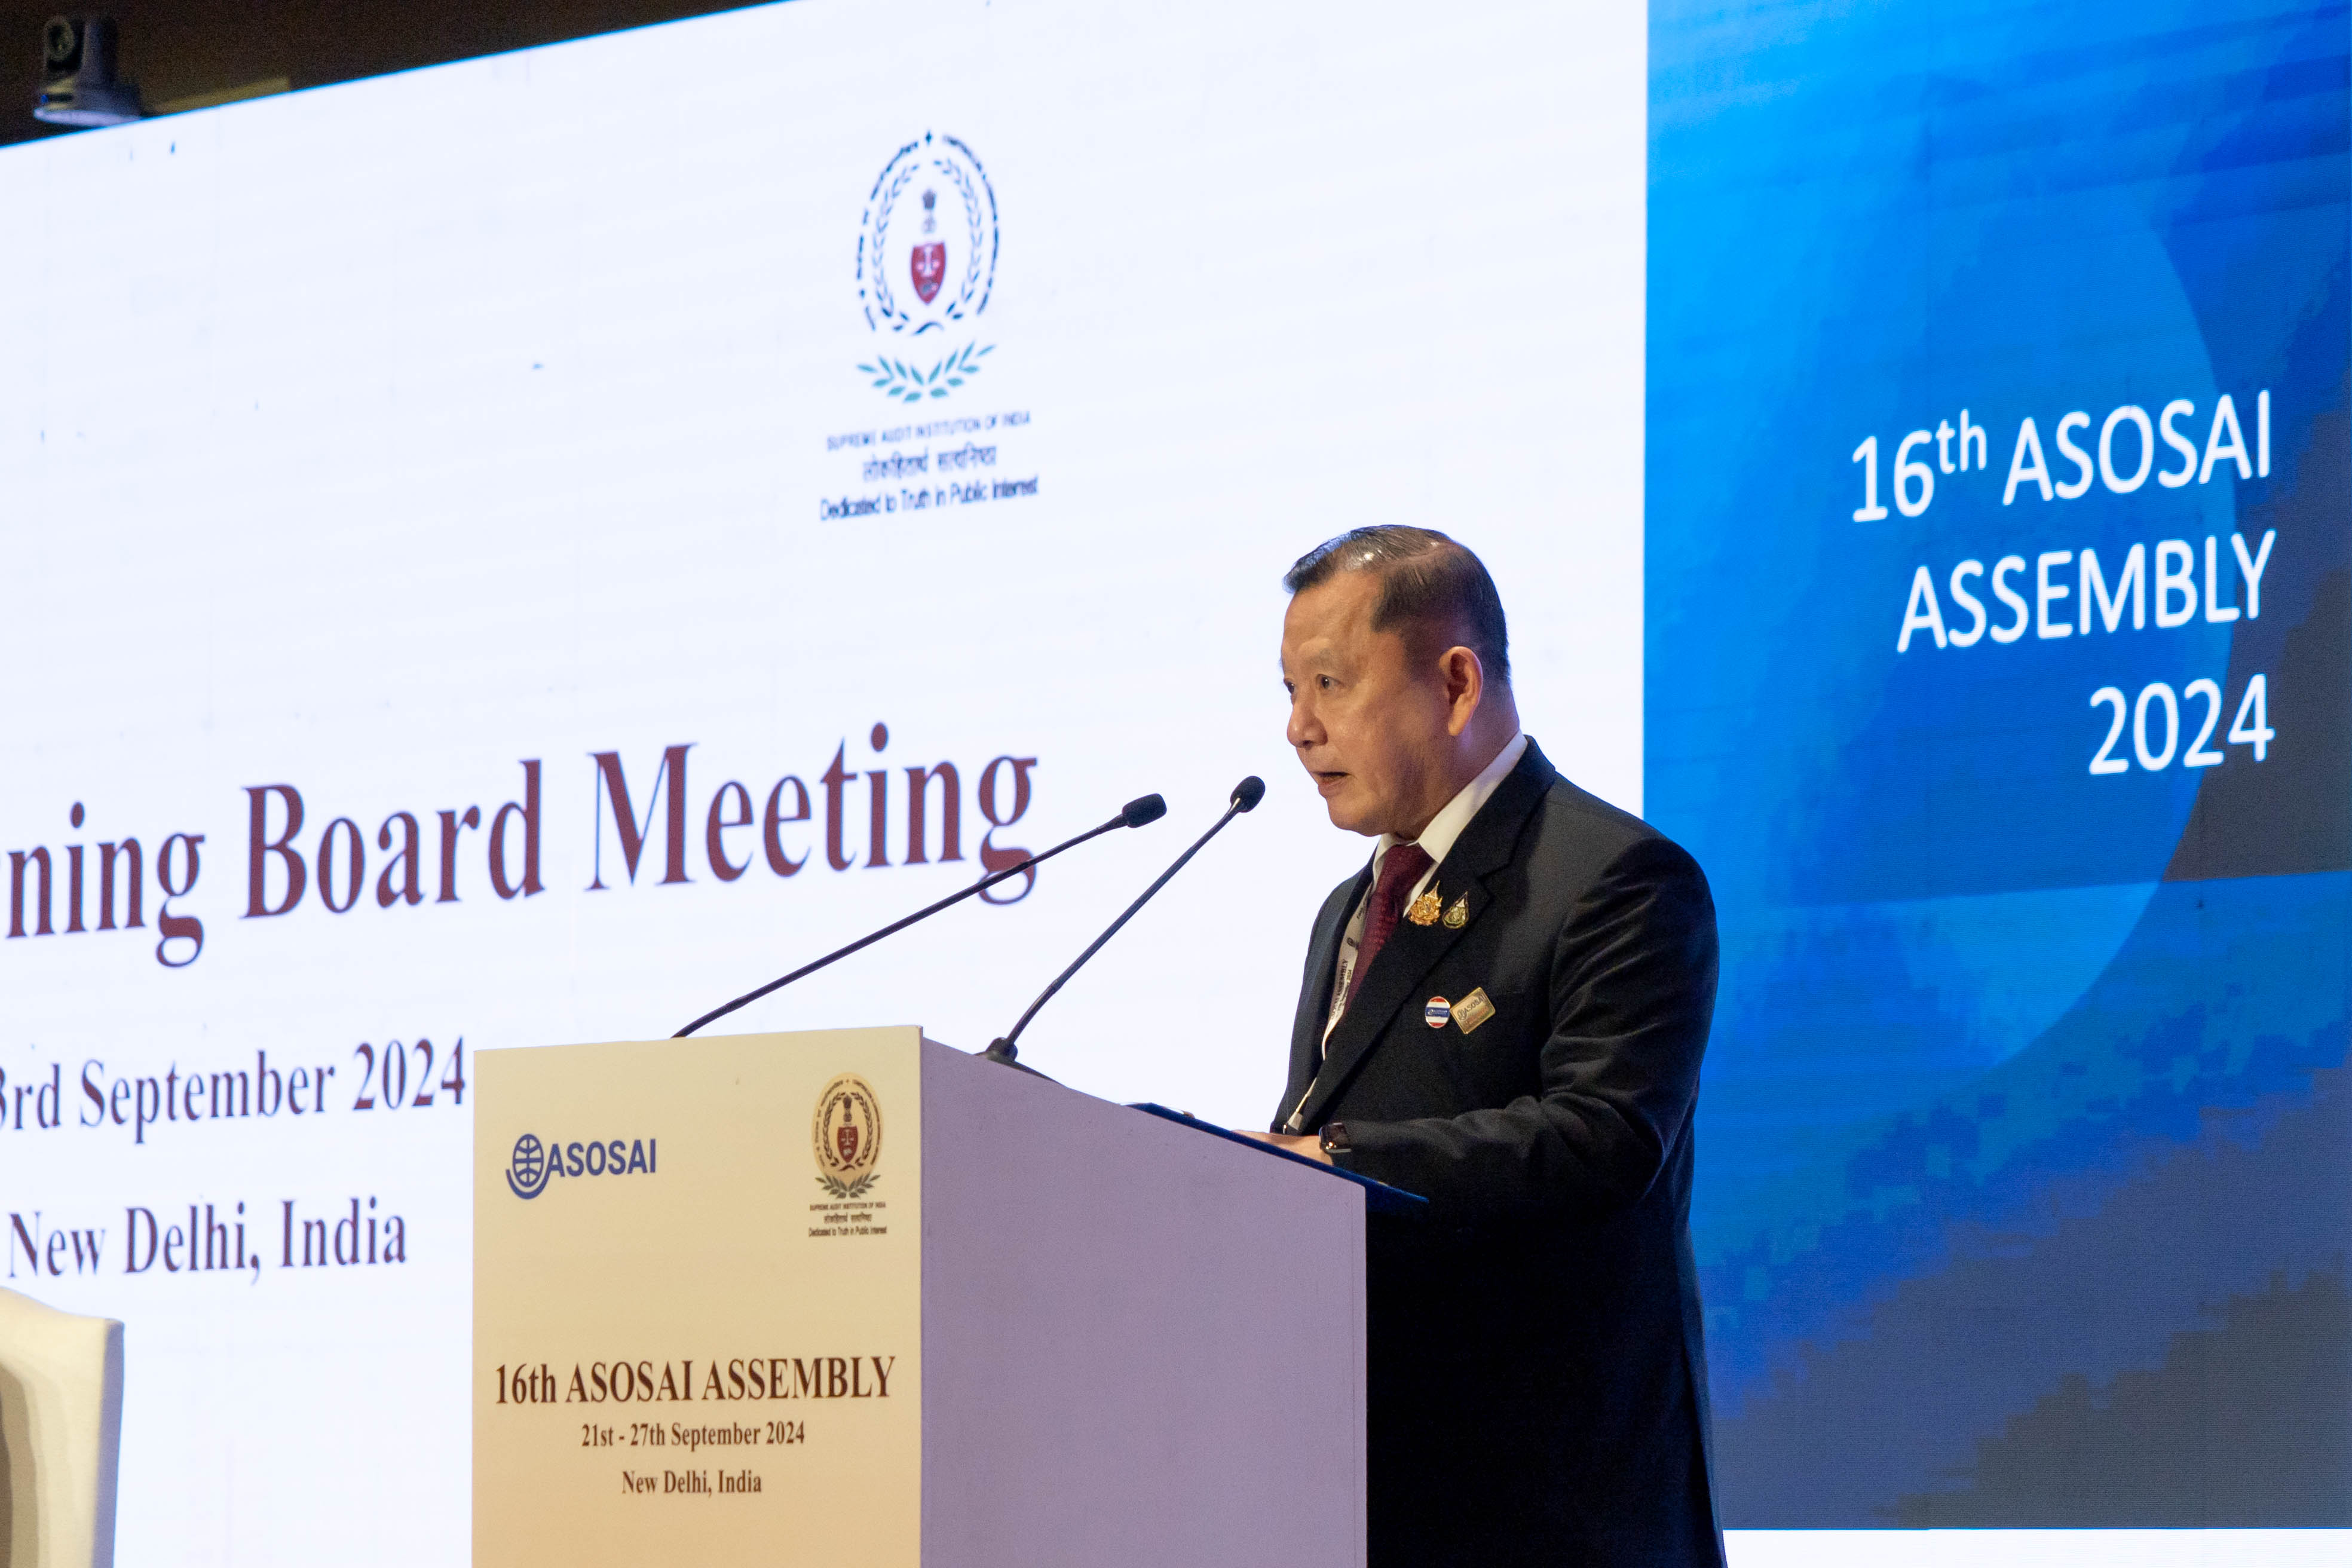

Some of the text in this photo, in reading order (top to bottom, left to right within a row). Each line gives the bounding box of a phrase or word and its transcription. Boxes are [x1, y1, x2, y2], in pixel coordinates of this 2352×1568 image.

[951, 477, 987, 503] Public
[1852, 390, 2270, 523] 16th ASOSAI
[1897, 529, 2276, 653] ASSEMBLY
[2089, 674, 2274, 776] 2024
[5, 722, 1039, 969] ning Board Meeting
[79, 1050, 336, 1146] September
[353, 1037, 466, 1111] 2024
[545, 1139, 656, 1179] ASOSAI
[9, 1196, 407, 1284] New Delhi, India
[496, 1356, 896, 1404] 16th ASOSAI ASSEMBLY
[581, 1423, 614, 1447] 21st
[630, 1423, 665, 1446] 27th
[671, 1422, 761, 1453] September
[766, 1420, 805, 1445] 2024
[622, 1469, 762, 1497] New Delhi, India
